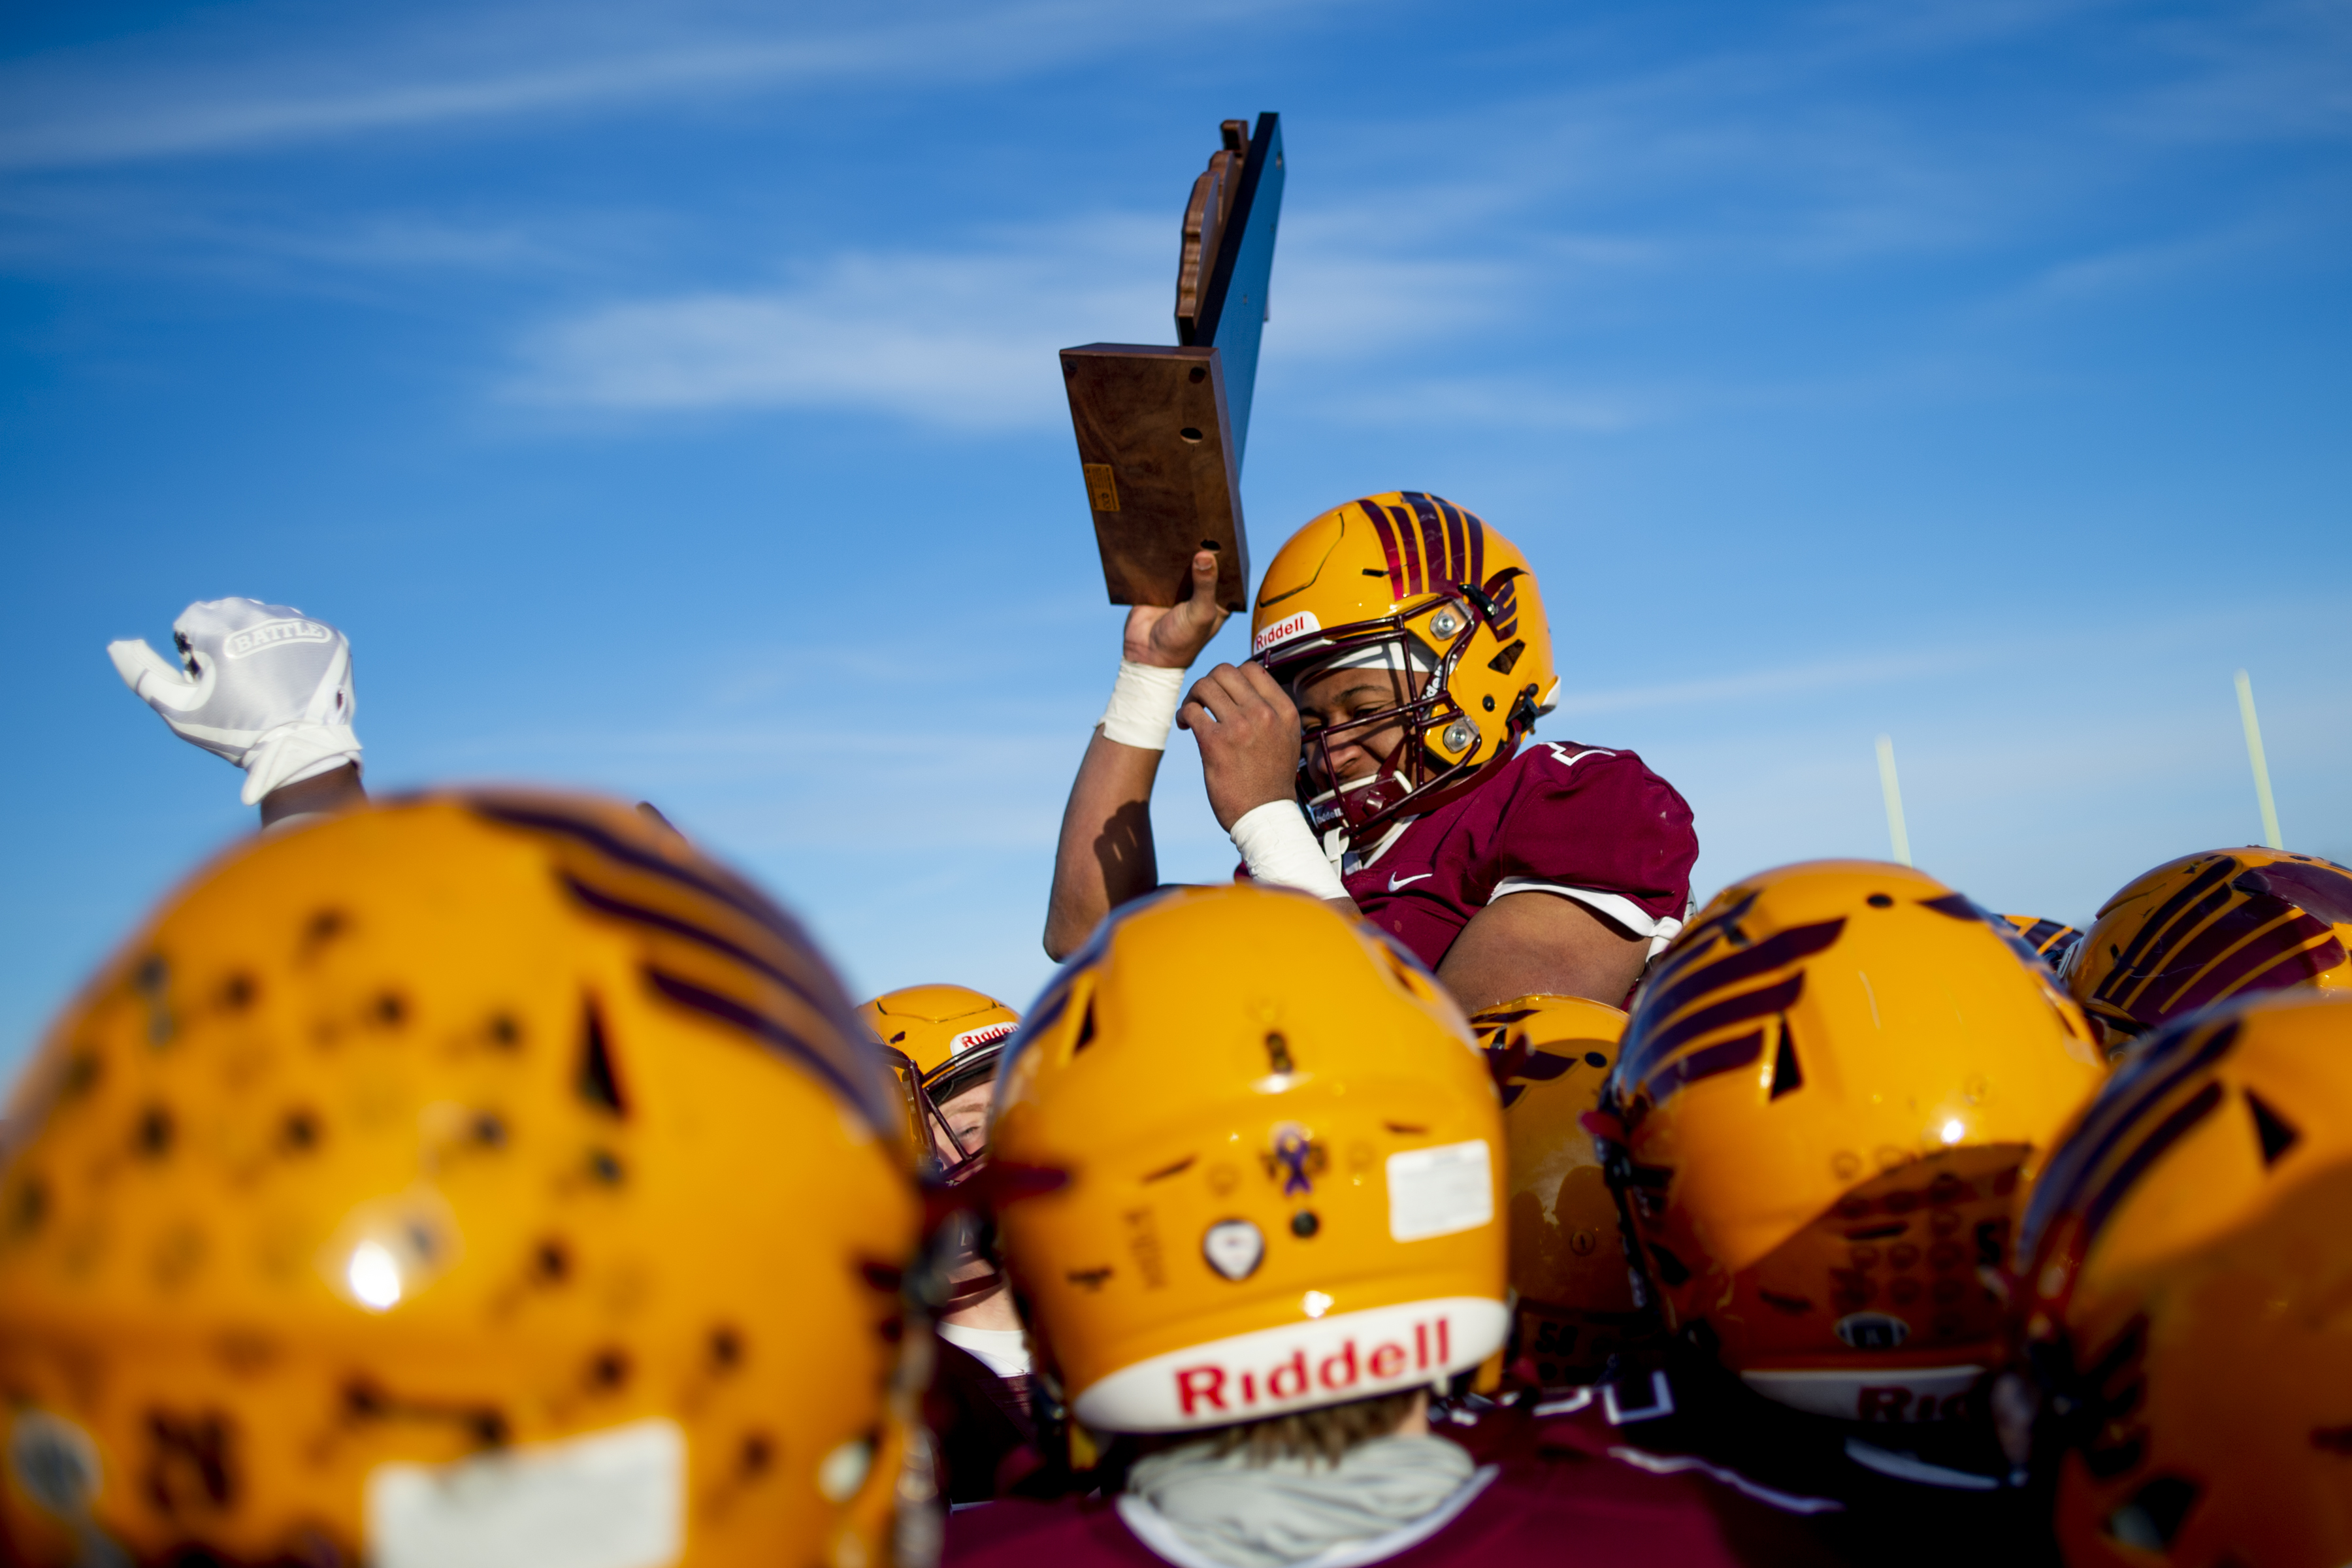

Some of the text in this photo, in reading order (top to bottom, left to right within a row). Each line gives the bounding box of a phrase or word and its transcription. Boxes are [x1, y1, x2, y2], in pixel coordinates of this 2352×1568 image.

[234, 622, 323, 652] BATTLE
[1256, 616, 1304, 650] Riddell
[1173, 1315, 1452, 1418] Riddell
